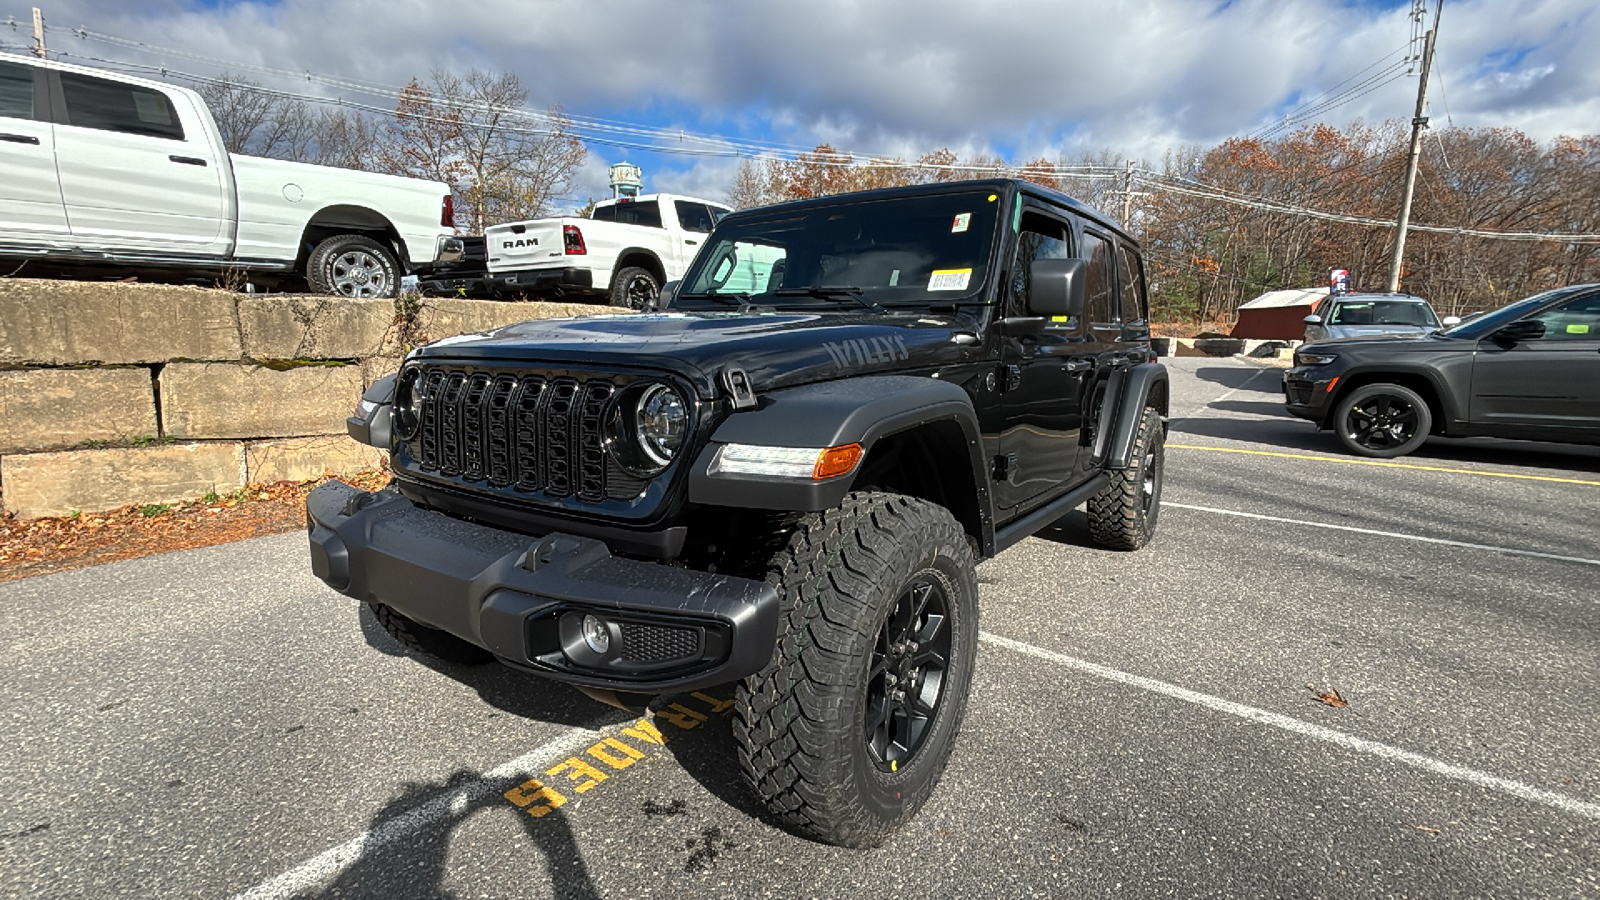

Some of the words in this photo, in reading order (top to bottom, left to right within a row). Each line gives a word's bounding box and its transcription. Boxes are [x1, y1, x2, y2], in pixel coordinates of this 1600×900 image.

[503, 238, 539, 248] RAM
[821, 334, 909, 369] WILLYS
[503, 691, 736, 818] TRADES
